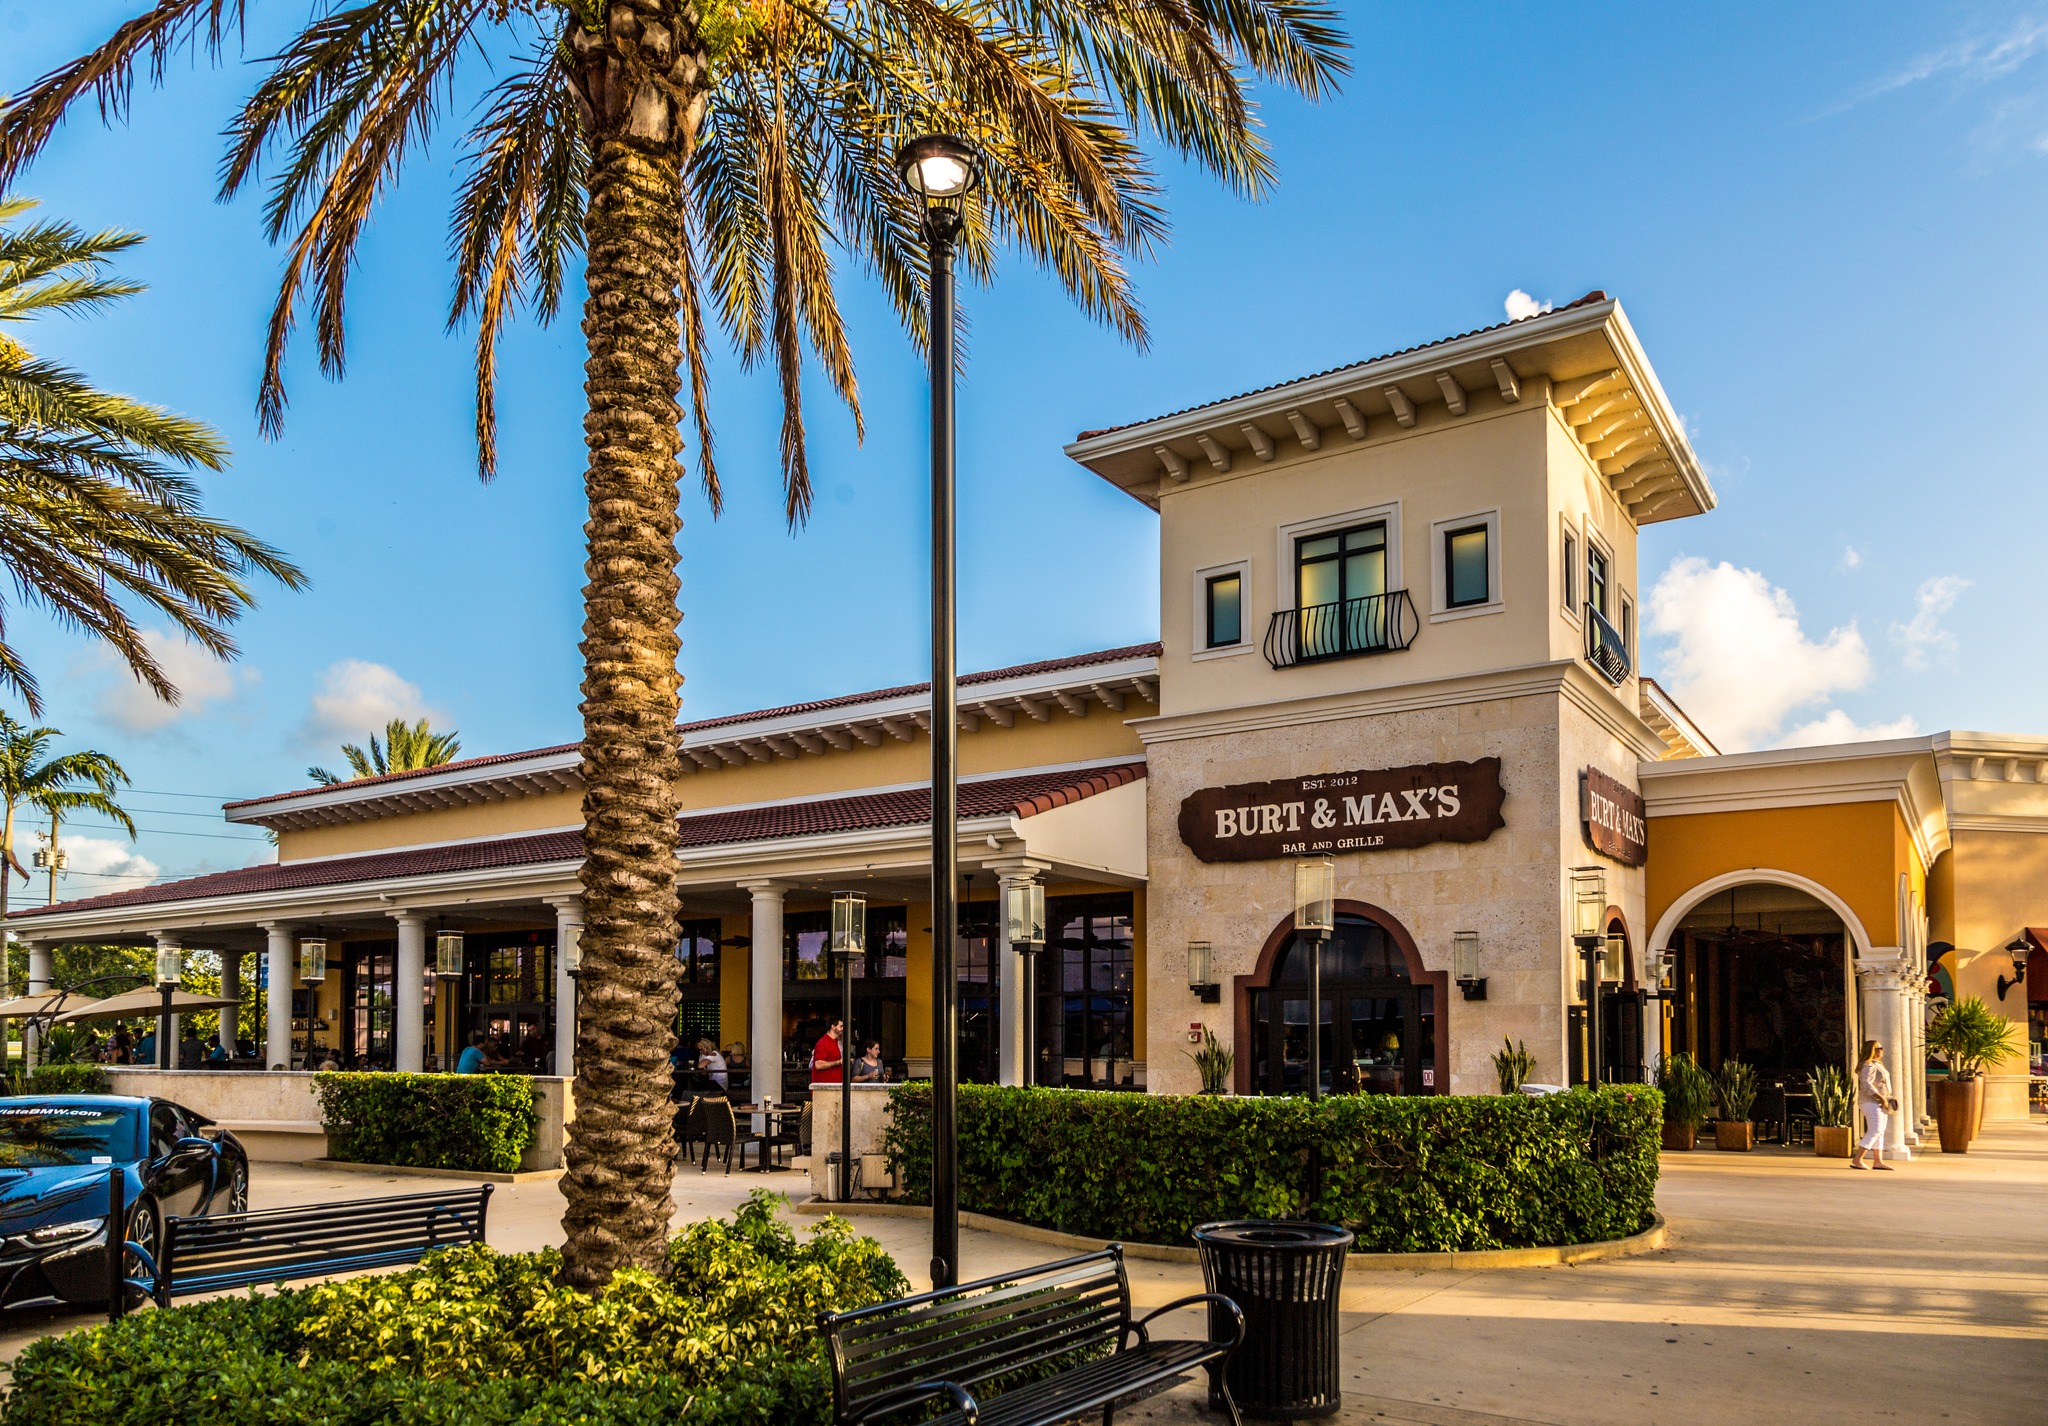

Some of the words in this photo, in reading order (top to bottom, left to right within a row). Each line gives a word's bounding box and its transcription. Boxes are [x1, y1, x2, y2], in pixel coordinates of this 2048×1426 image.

[1302, 780, 1327, 790] EST.
[1331, 776, 1358, 787] 2012
[1215, 801, 1305, 838] BURT
[1311, 798, 1337, 829] &
[1342, 785, 1461, 827] MAX'S
[1591, 790, 1615, 831] BURT
[1622, 809, 1645, 847] MAX'S
[1282, 842, 1306, 853] BAR
[1312, 841, 1333, 850] AND
[1337, 836, 1384, 848] GRILLE
